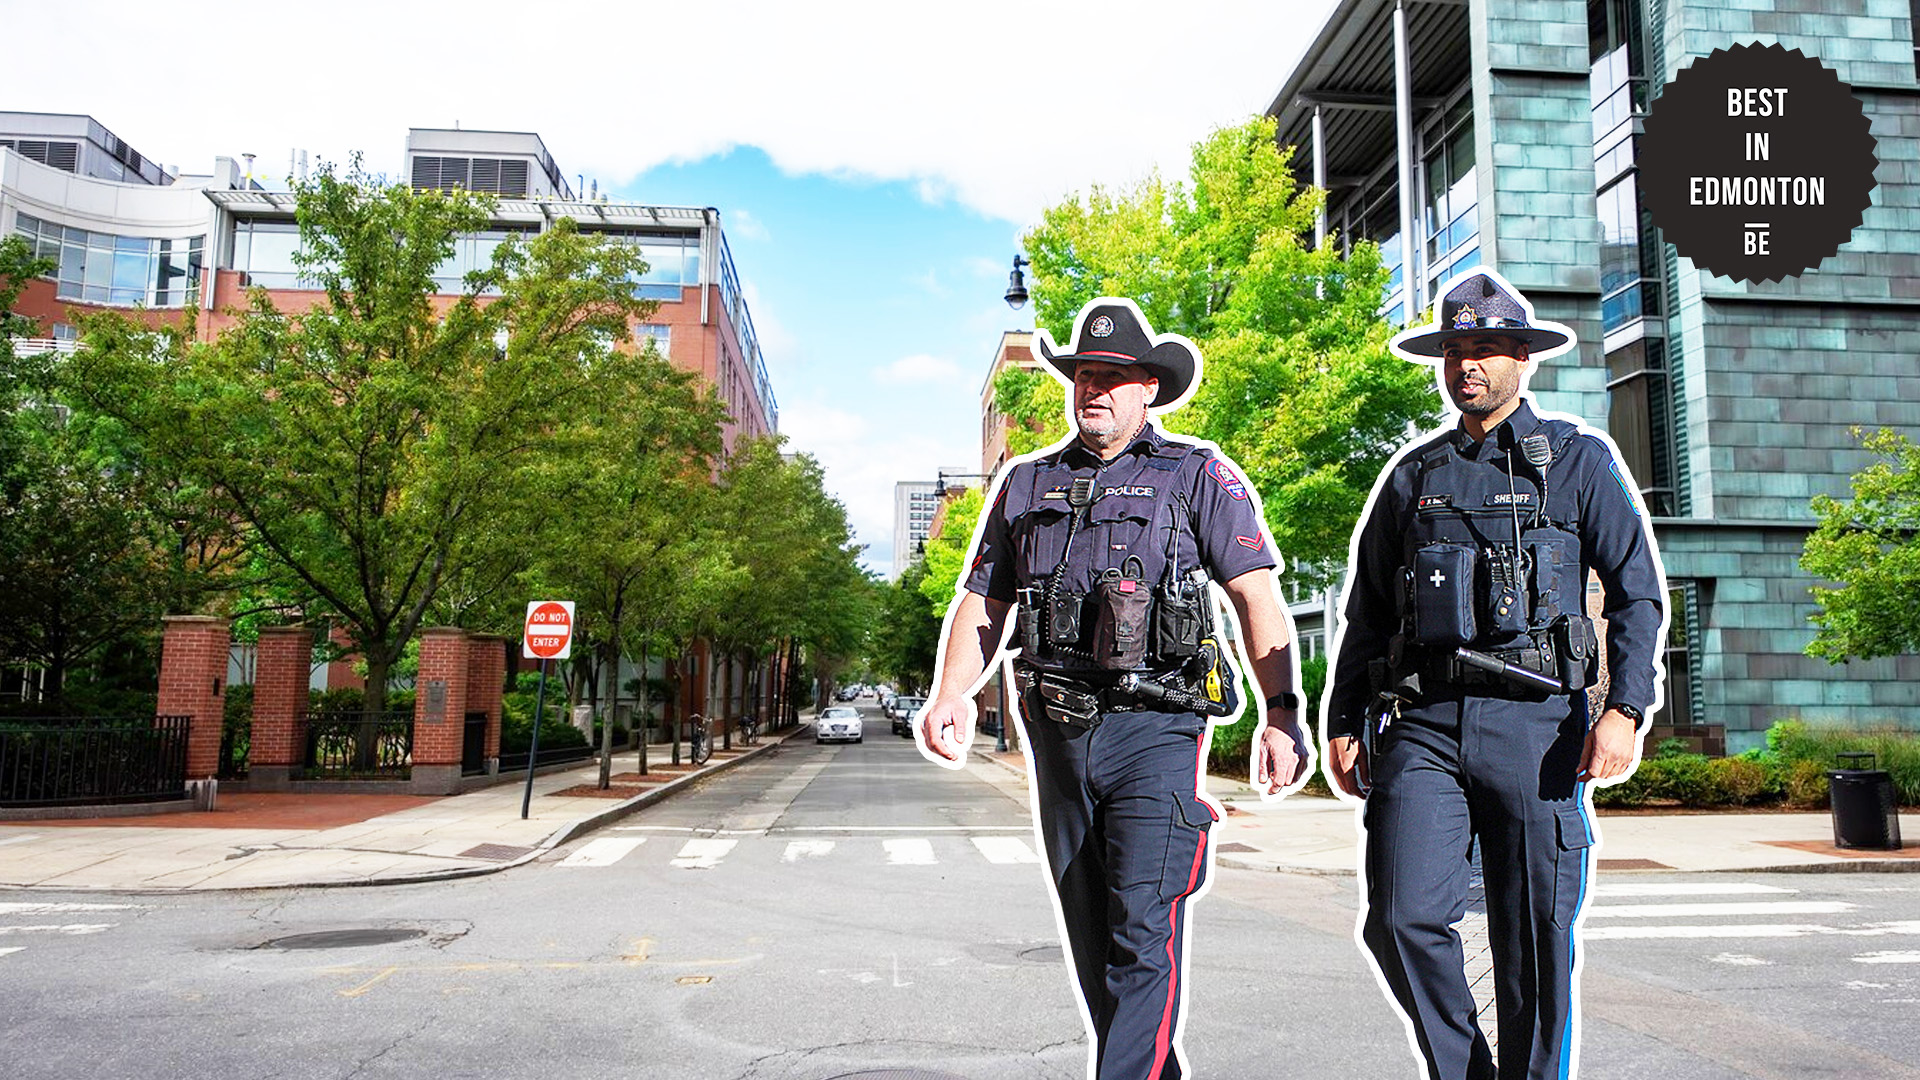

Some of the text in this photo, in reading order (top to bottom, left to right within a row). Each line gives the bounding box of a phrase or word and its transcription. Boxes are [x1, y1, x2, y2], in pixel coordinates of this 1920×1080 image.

[1105, 485, 1154, 496] POLICE
[1494, 494, 1530, 504] SHERIFF
[534, 613, 566, 622] DO NOT
[533, 638, 559, 647] ENTER
